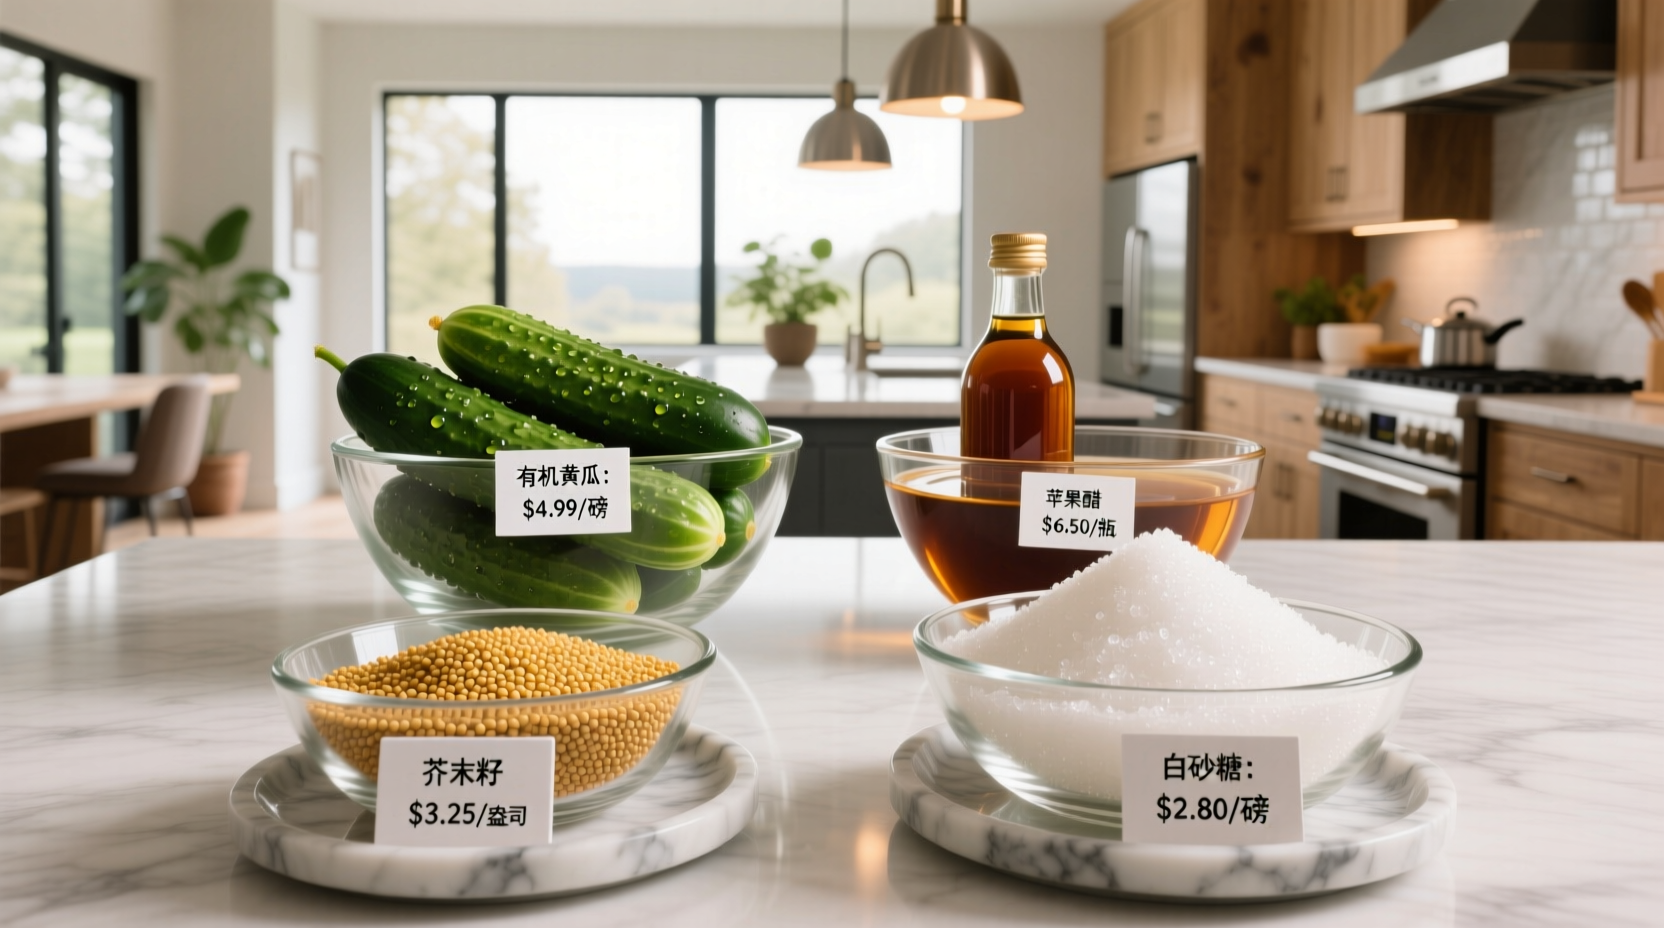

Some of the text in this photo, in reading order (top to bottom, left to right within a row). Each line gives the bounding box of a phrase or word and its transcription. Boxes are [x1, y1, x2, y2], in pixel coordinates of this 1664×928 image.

[516, 463, 609, 488] 有机黄瓜：
[522, 495, 609, 522] $4.99/磅
[1045, 488, 1102, 510] 苹果醋
[1041, 514, 1117, 539] $6.50/瓶
[422, 757, 504, 787] 芥末籽
[1163, 752, 1253, 782] 白砂糖：
[408, 798, 527, 829] $3.25/盎司
[1156, 792, 1270, 825] $2.80/磅
